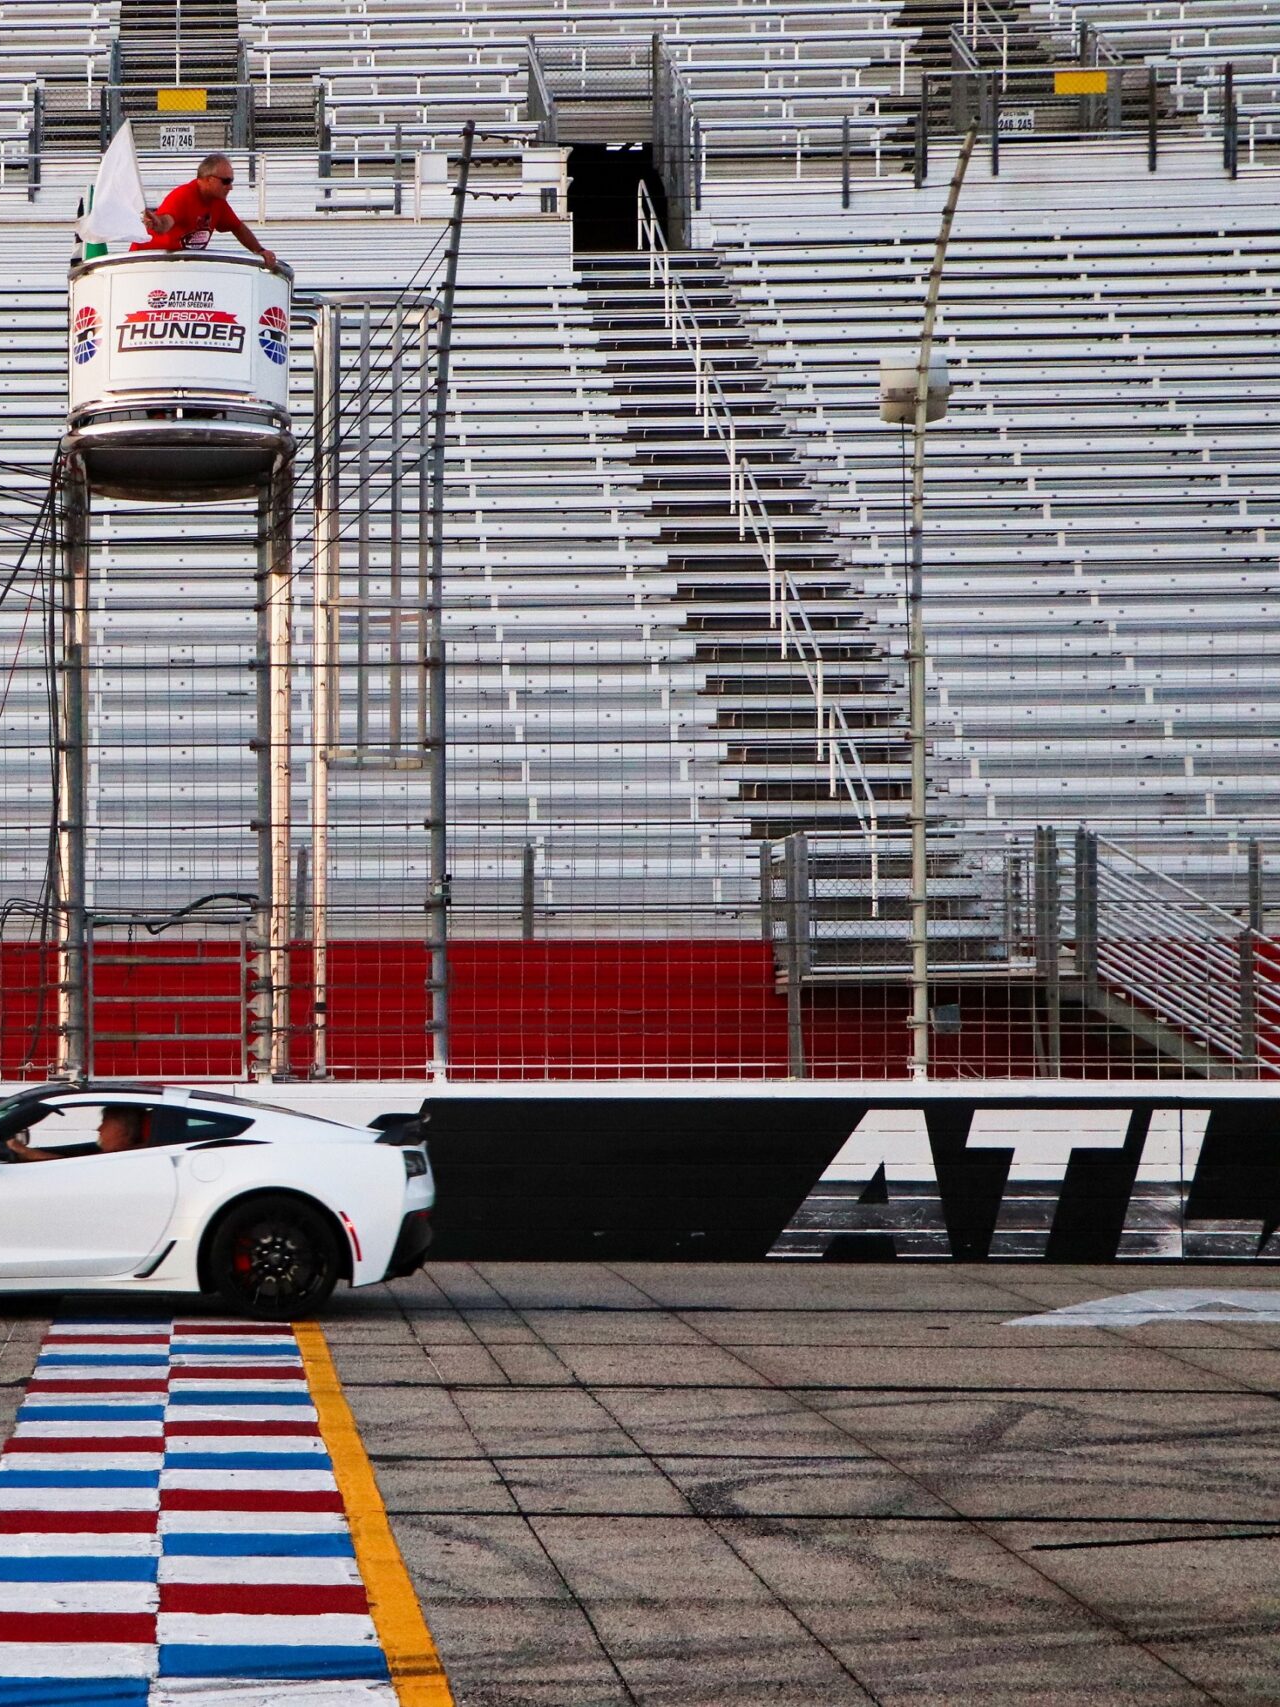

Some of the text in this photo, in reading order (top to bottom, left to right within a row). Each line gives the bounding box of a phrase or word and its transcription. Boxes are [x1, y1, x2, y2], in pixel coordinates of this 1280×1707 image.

[162, 135, 193, 147] 247 246
[169, 291, 214, 301] ATLANTA
[147, 312, 214, 321] THURSDAY
[116, 323, 246, 342] THUNDER
[766, 1109, 1280, 1257] ATL
